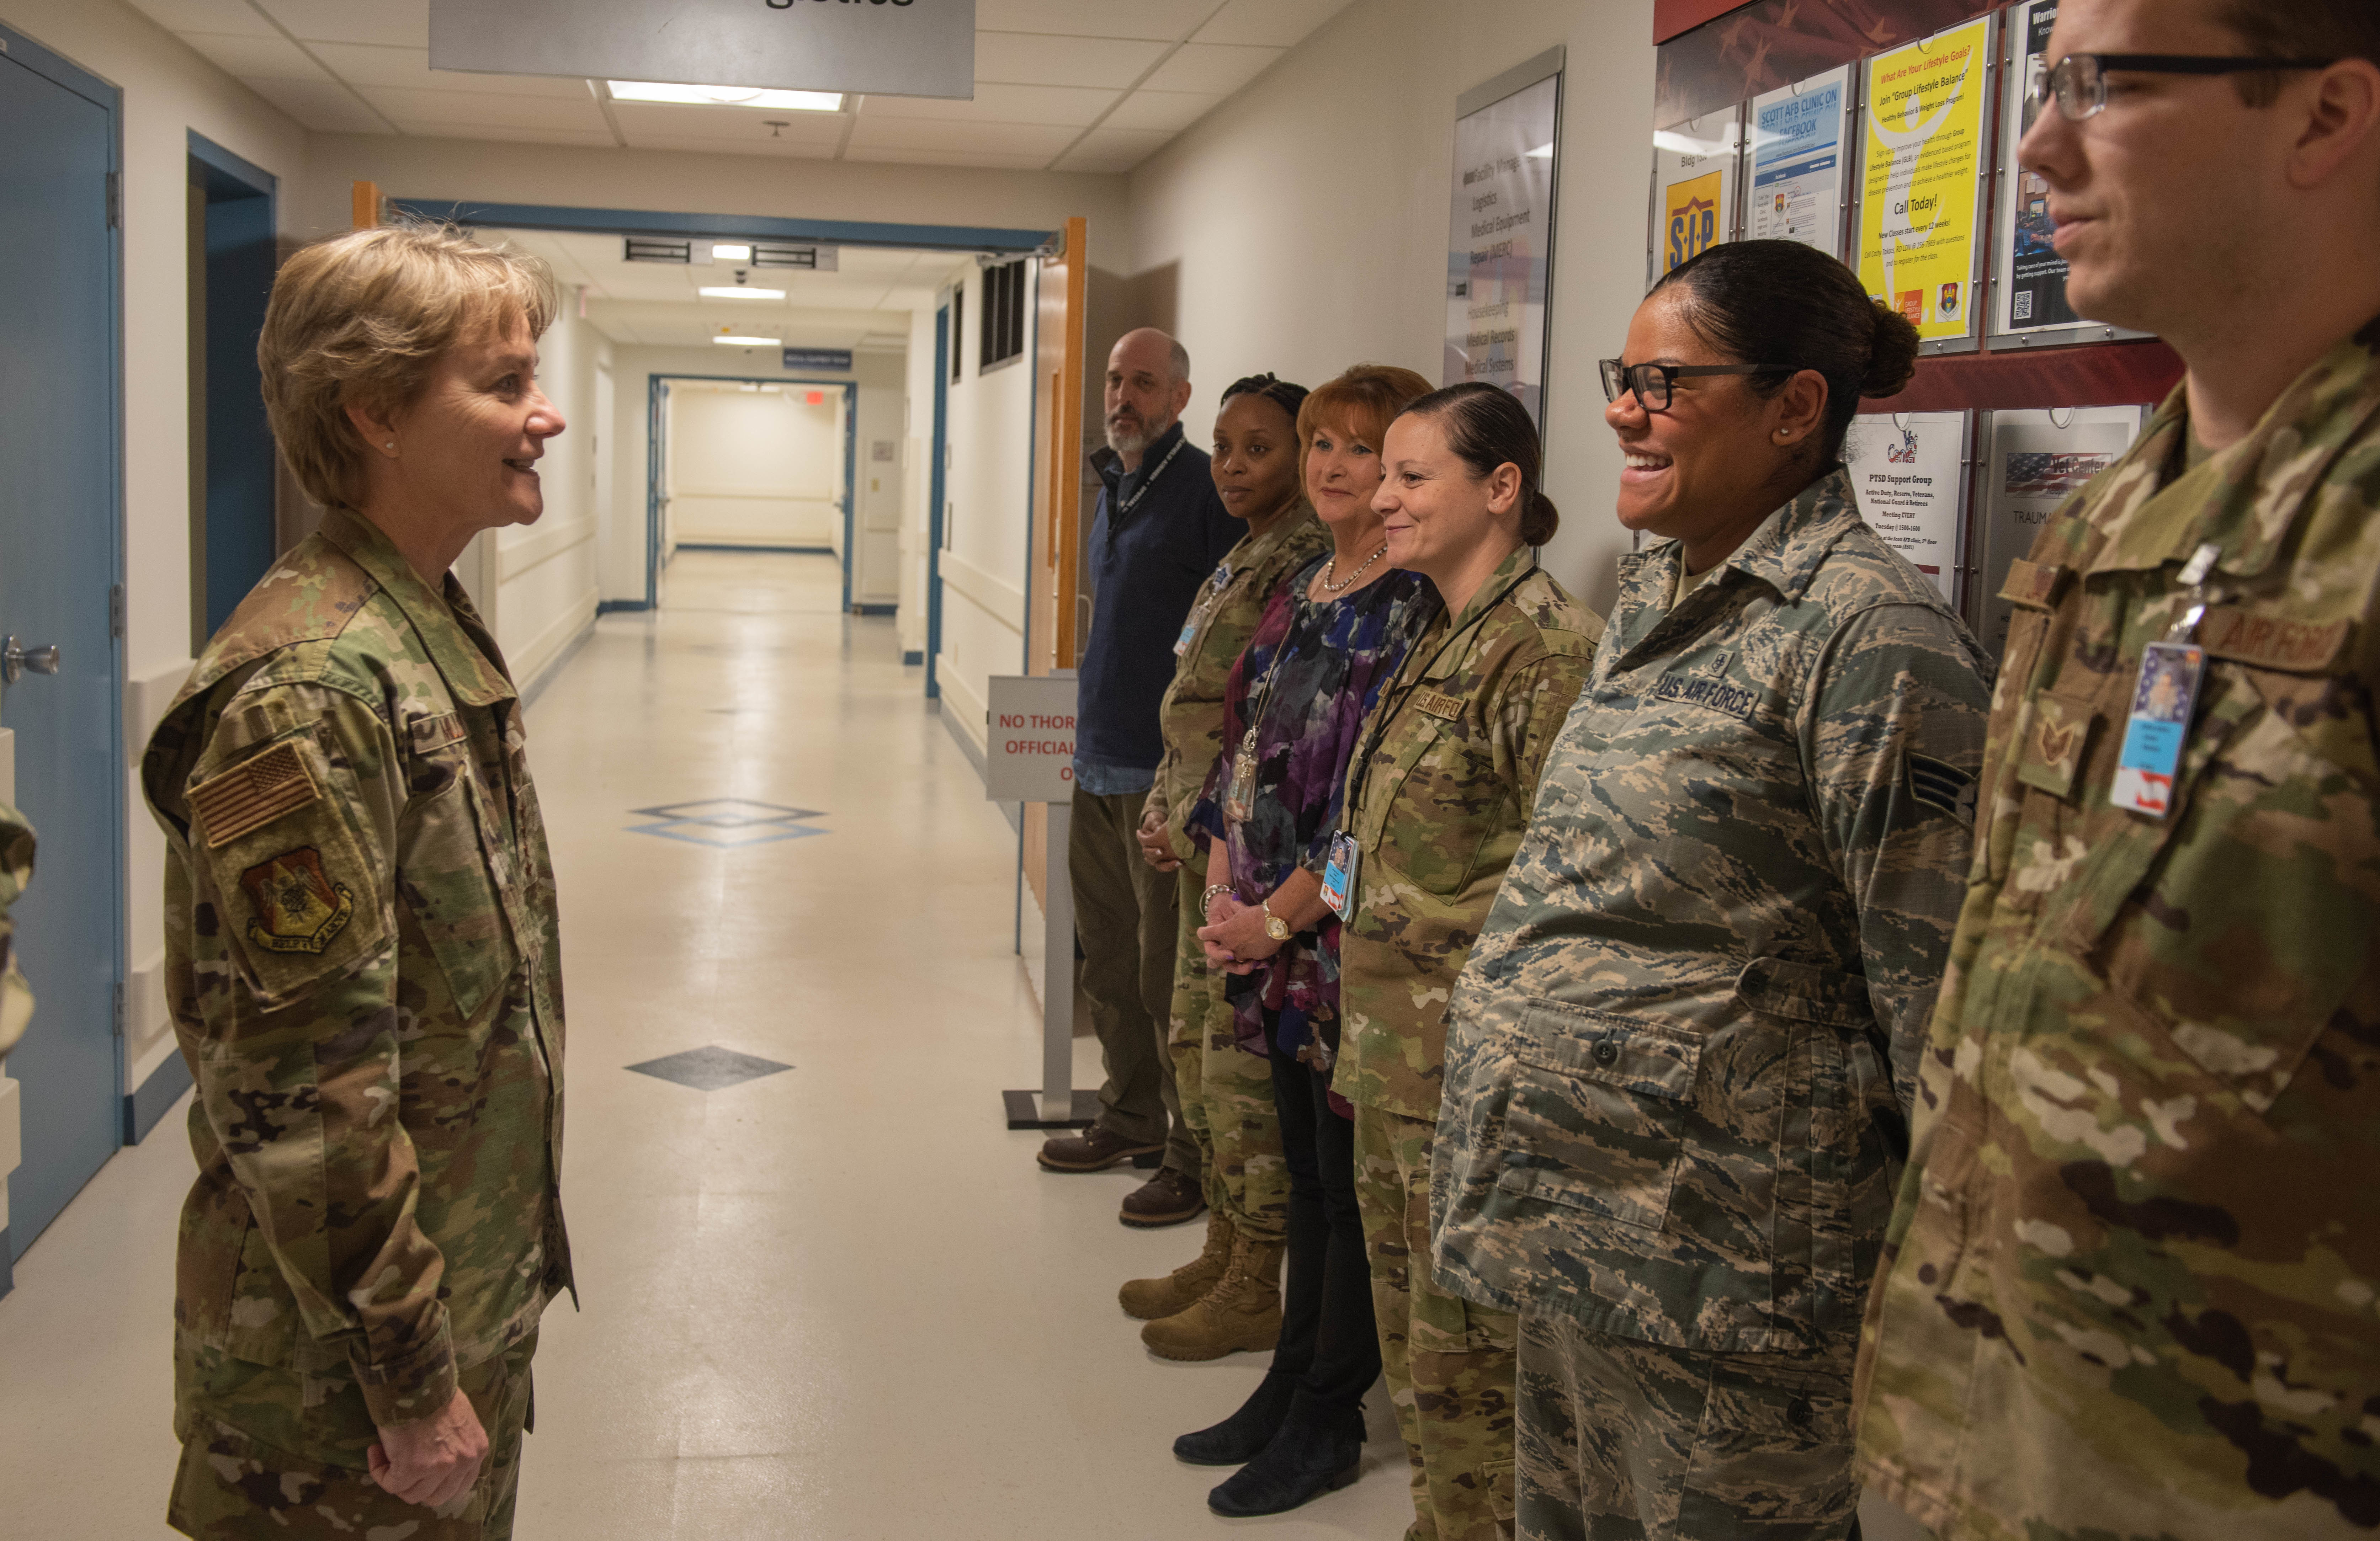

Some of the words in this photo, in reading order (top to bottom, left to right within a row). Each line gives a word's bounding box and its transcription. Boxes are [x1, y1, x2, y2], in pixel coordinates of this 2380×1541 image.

[1881, 73, 1896, 84] What
[1896, 70, 1907, 78] Are
[1908, 64, 1922, 75] Your
[1923, 54, 1949, 70] Lifestyle
[1950, 45, 1971, 61] Goals?
[1880, 95, 1890, 106] Join
[1913, 79, 1939, 95] Lifestyle
[1762, 107, 1784, 124] SCOTT
[1785, 102, 1799, 118] AFB
[1801, 93, 1824, 112] CLINIC
[1825, 88, 1837, 104] ON
[1881, 113, 1896, 123] Healthy
[1897, 109, 1915, 118] Behavior
[1919, 103, 1934, 112] Weight
[1945, 92, 1965, 105] Program!
[1780, 118, 1817, 137] FACEBOOK
[1896, 142, 1912, 153] improve
[1912, 141, 1921, 149] your
[1922, 135, 1935, 145] health
[1936, 132, 1952, 143] through
[1953, 128, 1965, 138] Group
[1681, 155, 1695, 167] Bldg
[1870, 163, 1884, 171] Lifestyle
[1885, 158, 1901, 167] Balance
[1942, 145, 1954, 154] based
[1954, 140, 1971, 150] program
[1868, 176, 1884, 184] designed
[1899, 165, 1920, 177] individuals
[1921, 164, 1932, 172] make
[1933, 158, 1948, 168] lifestyle
[1948, 154, 1964, 165] changes
[1868, 188, 1881, 196] disease
[1882, 183, 1902, 195] prevention
[1917, 176, 1932, 185] achieve
[1936, 171, 1954, 181] healthier
[1473, 190, 1497, 212] Logistics
[1895, 200, 1908, 215] Call
[1911, 193, 1937, 212] Today!
[1471, 217, 1494, 239] Medical
[1496, 207, 1530, 233] Equipment
[1889, 229, 1904, 238] Classes
[1904, 226, 1915, 234] start
[1916, 223, 1928, 233] every
[1928, 222, 1934, 230] 12
[1935, 218, 1951, 228] weeks!
[1470, 247, 1489, 266] Repair
[1489, 238, 1512, 263] (MERC)
[1912, 242, 1916, 251] @
[1945, 234, 1965, 245] questions
[1898, 256, 1913, 266] register
[1467, 299, 1509, 320] Housekeeping
[1467, 329, 1489, 347] Medical
[1490, 326, 1514, 344] Records
[1465, 357, 1488, 375] Medical
[1489, 357, 1514, 375] Systems
[1903, 430, 1918, 450] Vet
[1888, 444, 1917, 463] Center
[2053, 457, 2069, 473] Vet
[2072, 457, 2105, 474] Center
[1869, 474, 1886, 482] PTSD
[1887, 475, 1911, 485] Support
[1912, 475, 1932, 486] Group
[1425, 694, 1447, 714] AIR
[1680, 680, 1708, 700] AIR
[1702, 683, 1754, 715] FORCE
[999, 714, 1025, 728] NO
[1030, 715, 1075, 730] THOR
[1005, 740, 1074, 755] OFFICIAL
